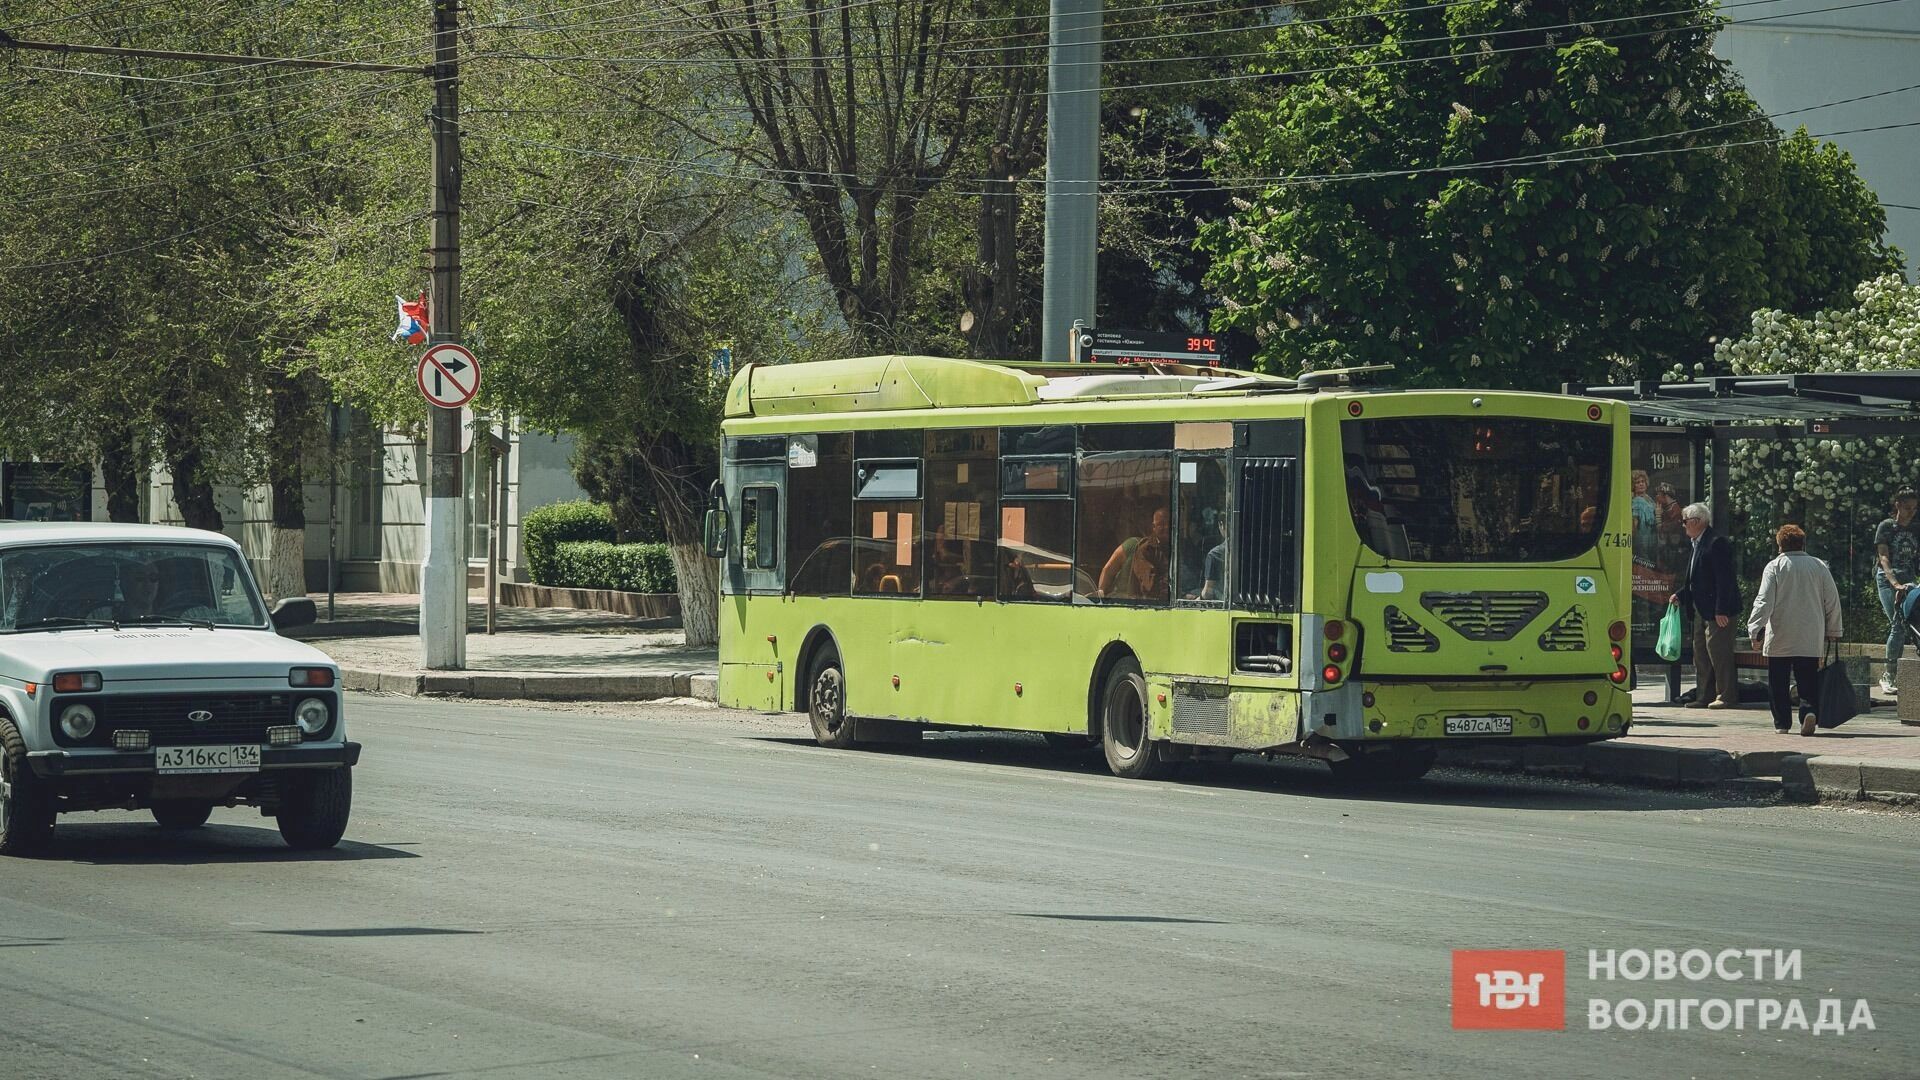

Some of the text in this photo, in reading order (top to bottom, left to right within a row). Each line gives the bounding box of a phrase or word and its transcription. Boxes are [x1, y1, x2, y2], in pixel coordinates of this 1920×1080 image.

[1187, 338, 1200, 351] 39
[1650, 453, 1665, 470] 19
[162, 746, 256, 766] А316КС 134
